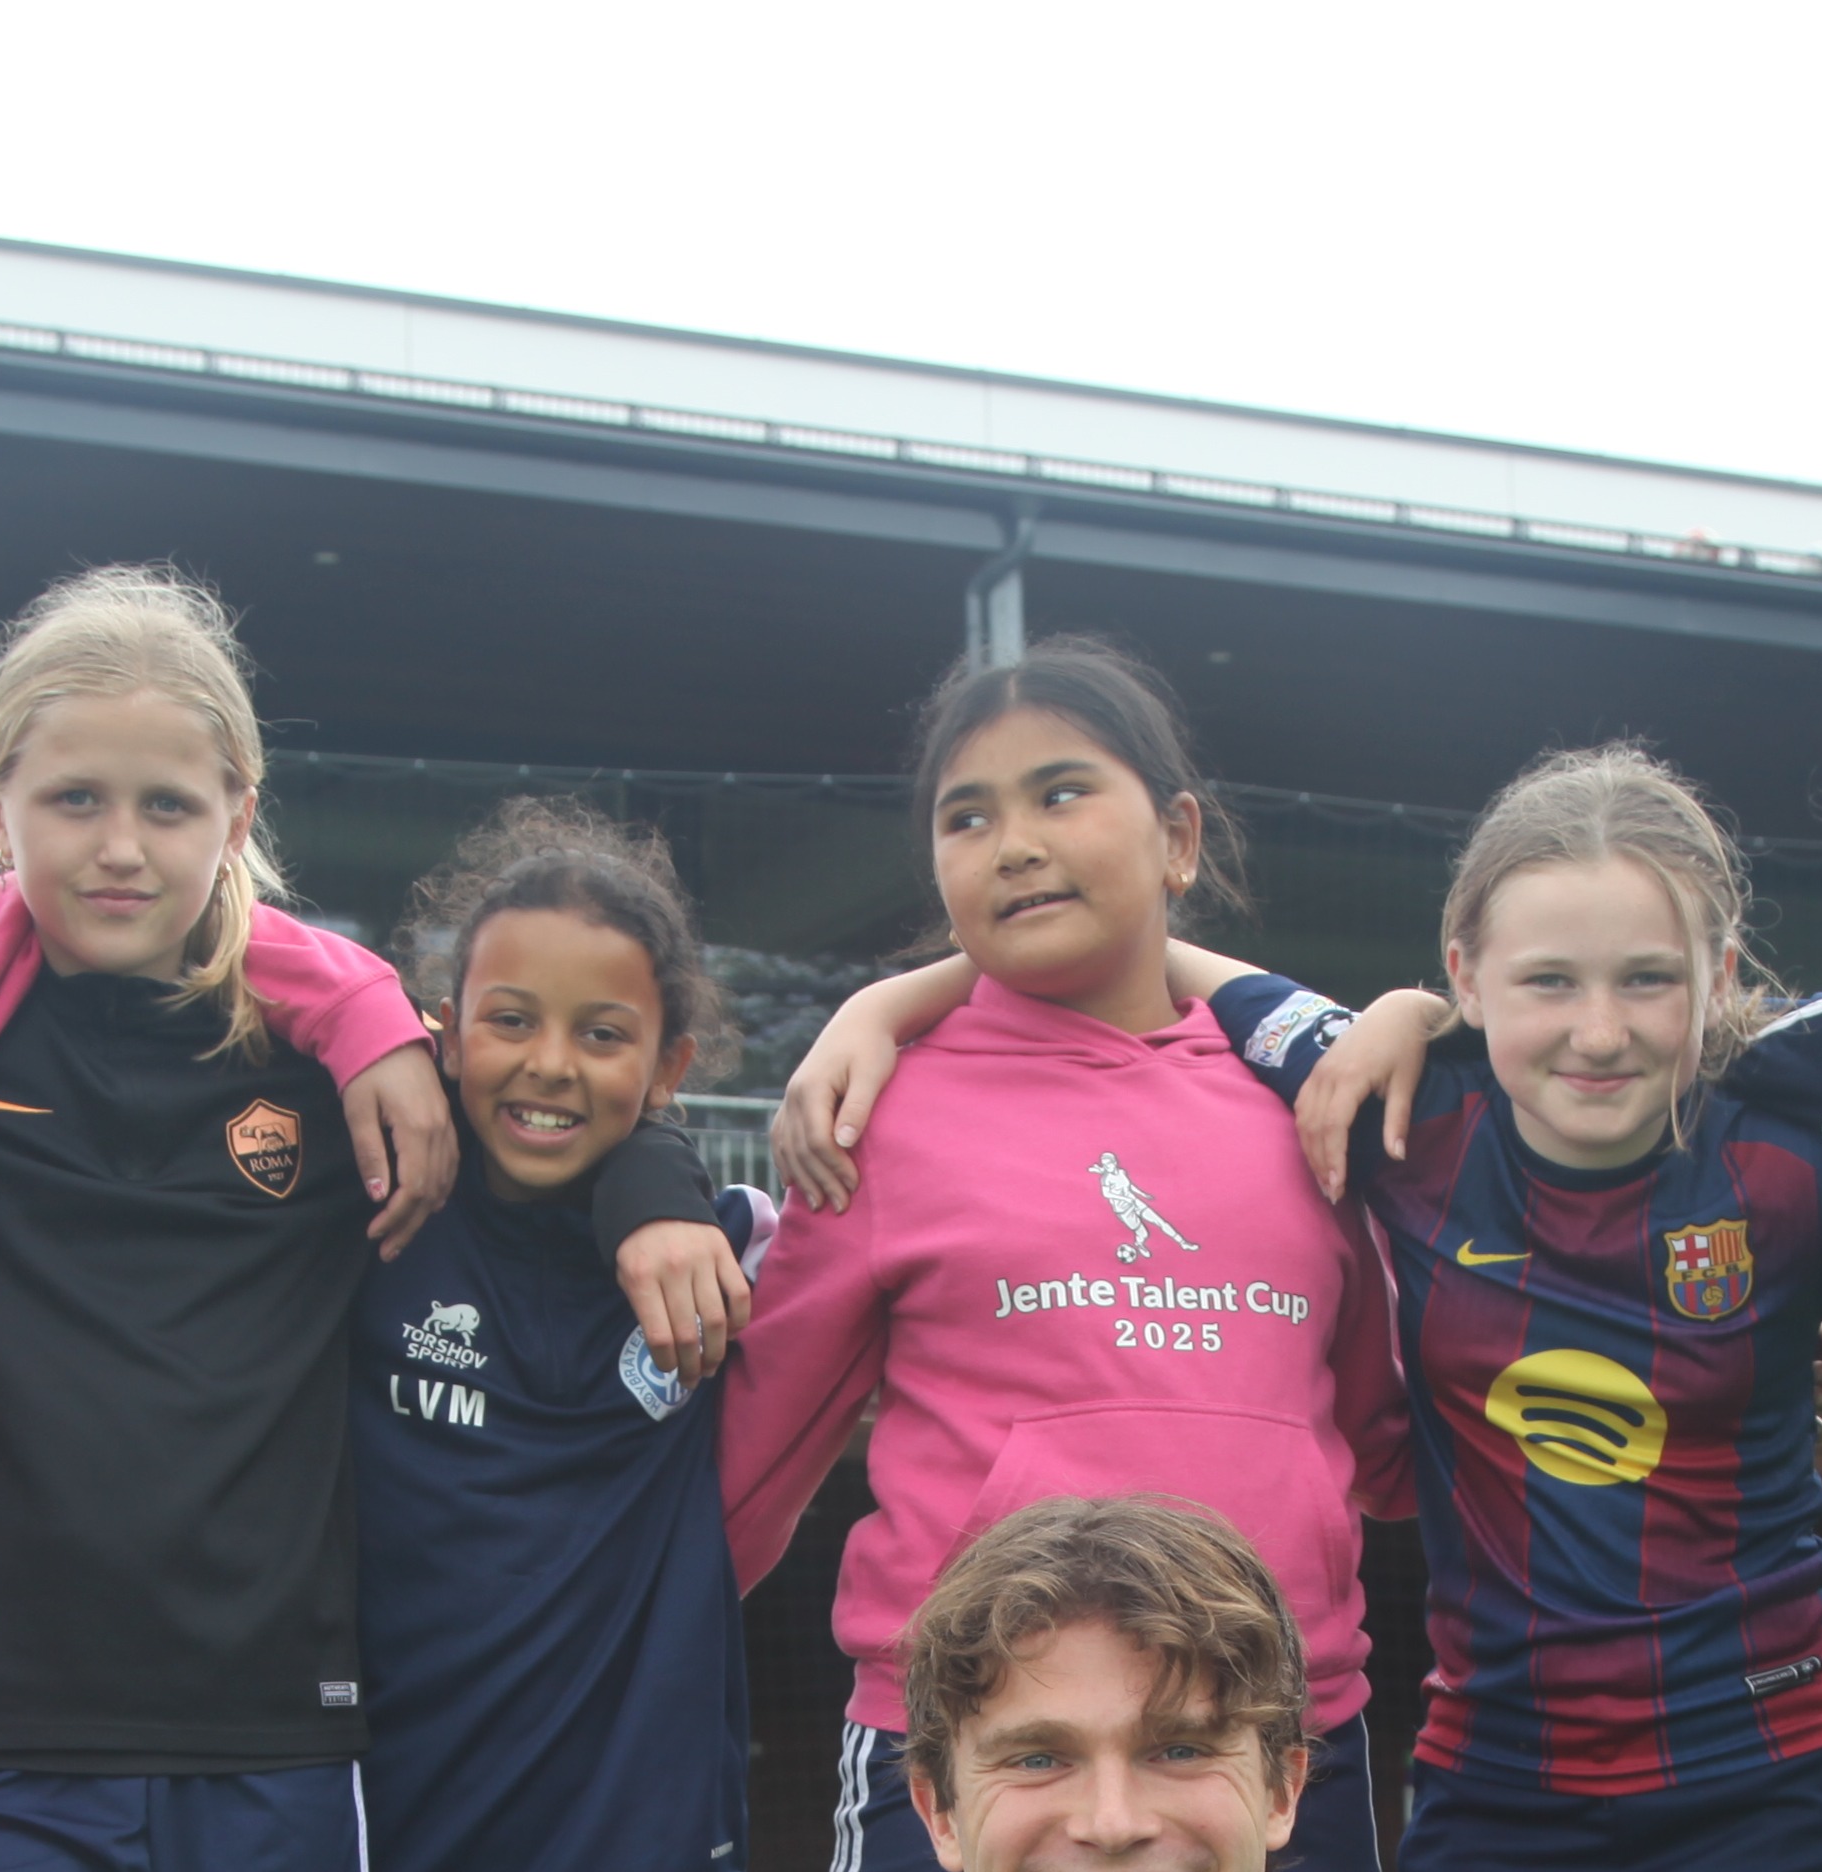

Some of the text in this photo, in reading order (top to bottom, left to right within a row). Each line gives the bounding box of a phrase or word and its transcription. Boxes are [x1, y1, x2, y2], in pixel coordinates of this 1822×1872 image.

[249, 1154, 294, 1173] ROMA
[995, 1272, 1310, 1325] Jente Talent Cup
[401, 1322, 489, 1370] TORSHOV
[1114, 1319, 1223, 1352] 2025
[406, 1342, 469, 1370] SPORT
[389, 1374, 487, 1427] LVM
